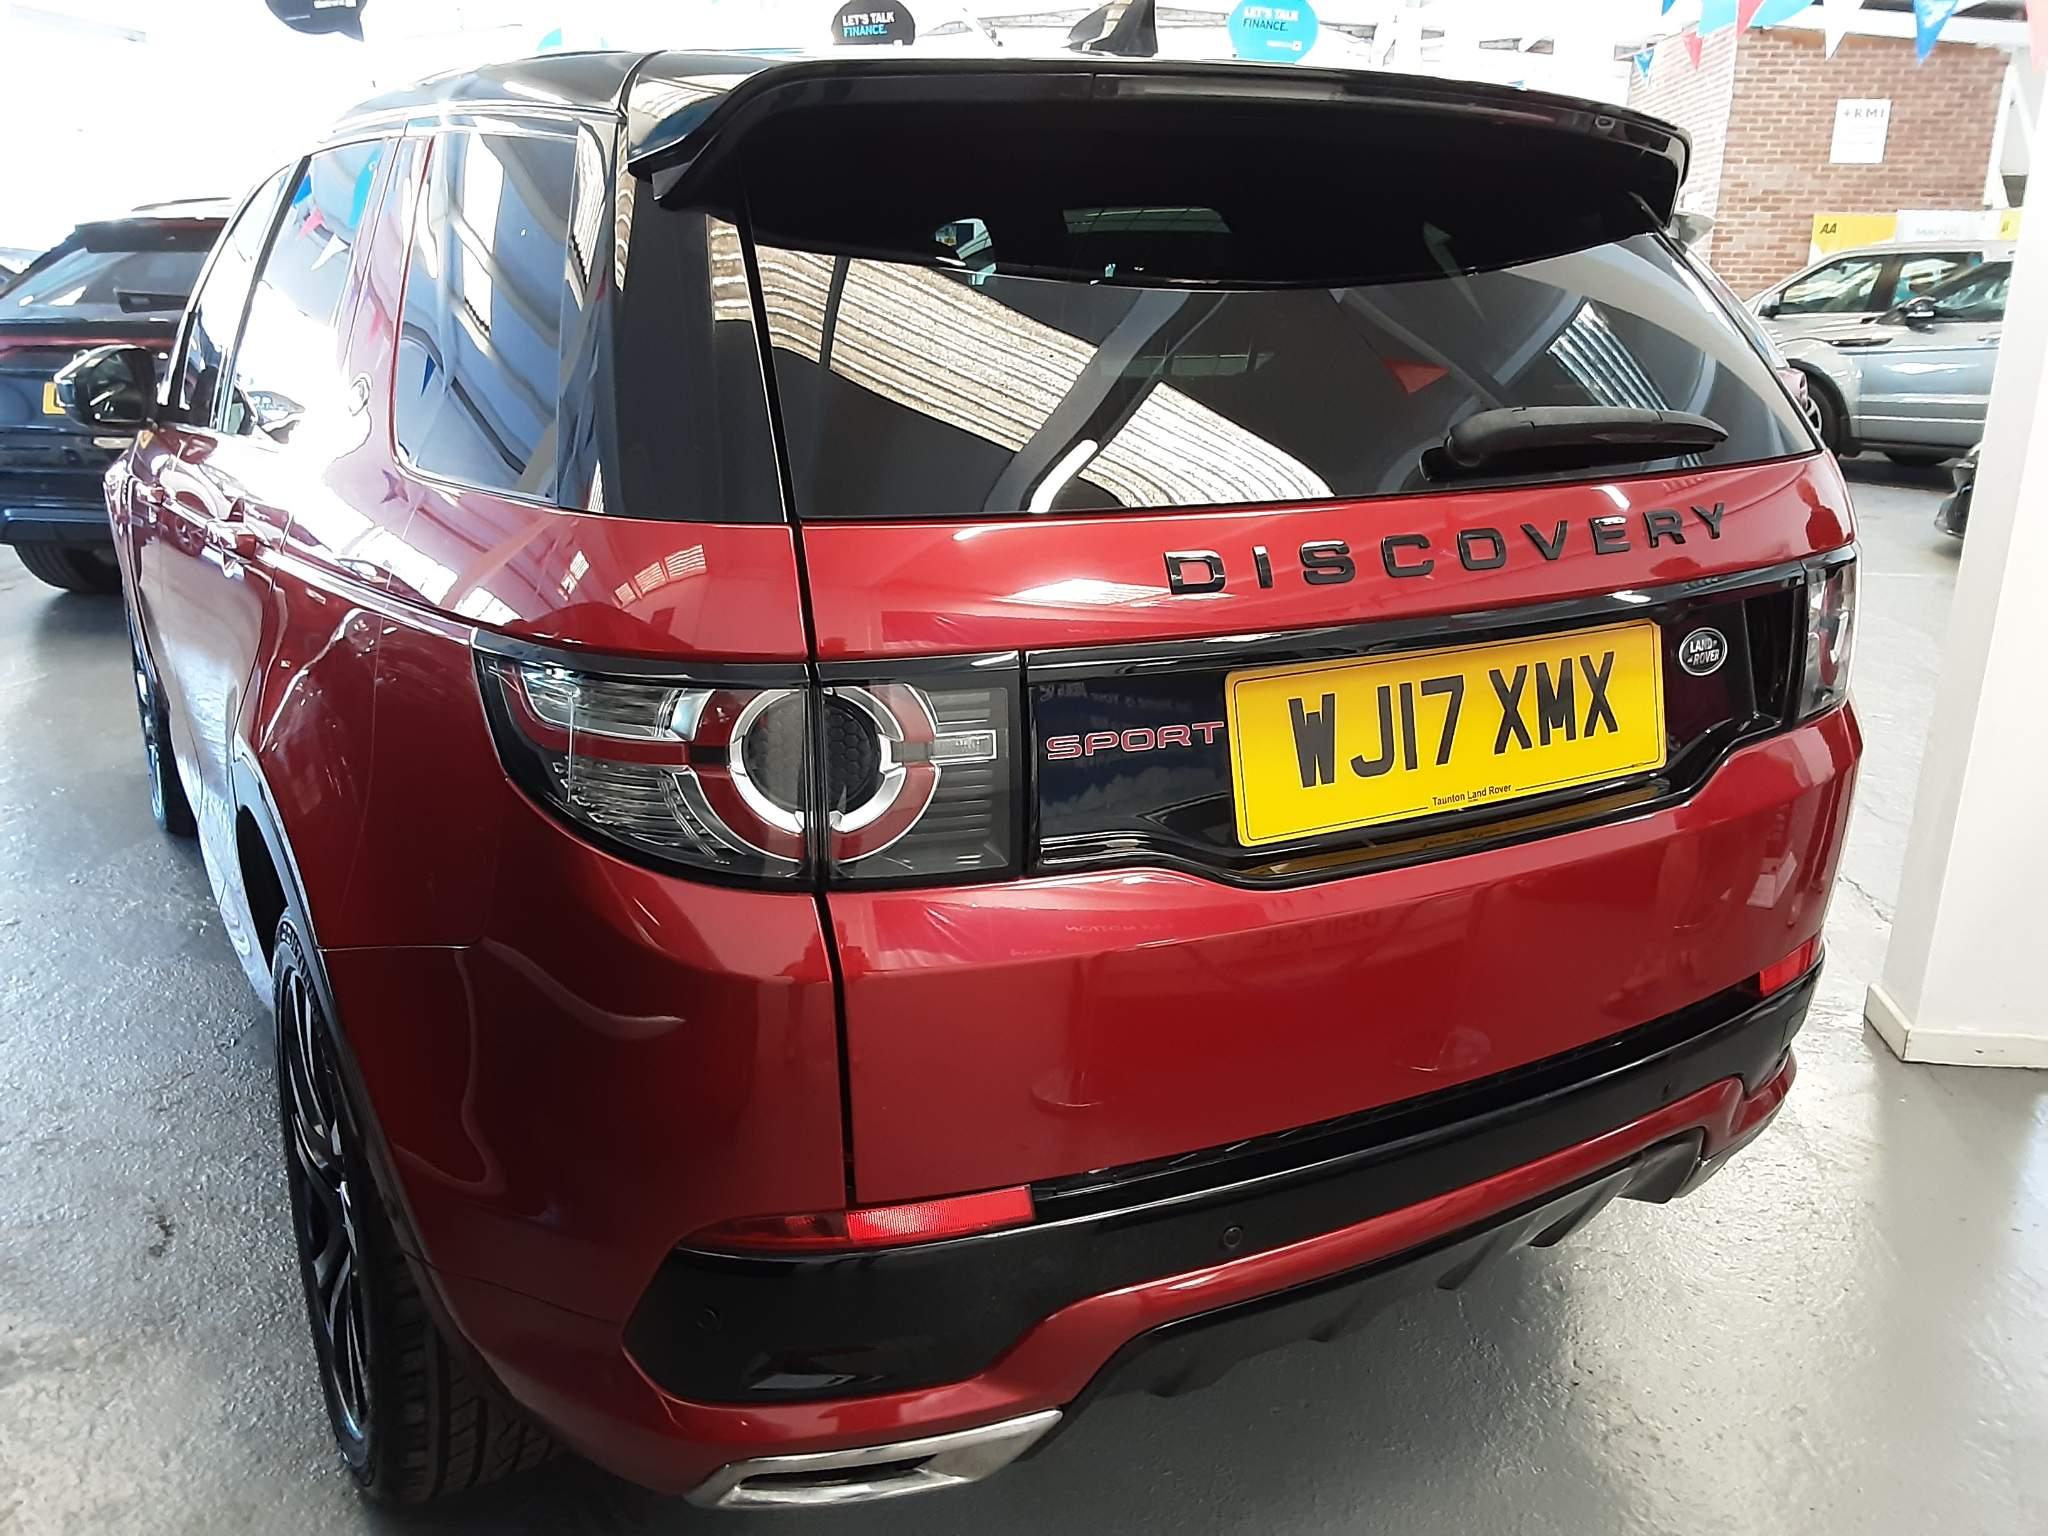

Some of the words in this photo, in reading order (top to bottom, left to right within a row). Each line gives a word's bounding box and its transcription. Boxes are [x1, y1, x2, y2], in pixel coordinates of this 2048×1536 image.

[842, 13, 869, 26] LET'S
[870, 11, 895, 24] TALK
[1819, 222, 1838, 235] AA
[1163, 502, 1724, 595] DISCOVERY
[1690, 637, 1713, 654] LAND
[1692, 648, 1720, 666] ROVER
[1287, 674, 1465, 788] WJ17
[1488, 651, 1619, 755] XMX
[1046, 721, 1225, 760] SPORT
[1432, 793, 1466, 806] Taunton
[1467, 787, 1487, 800] Land
[1488, 784, 1512, 795] Rover
